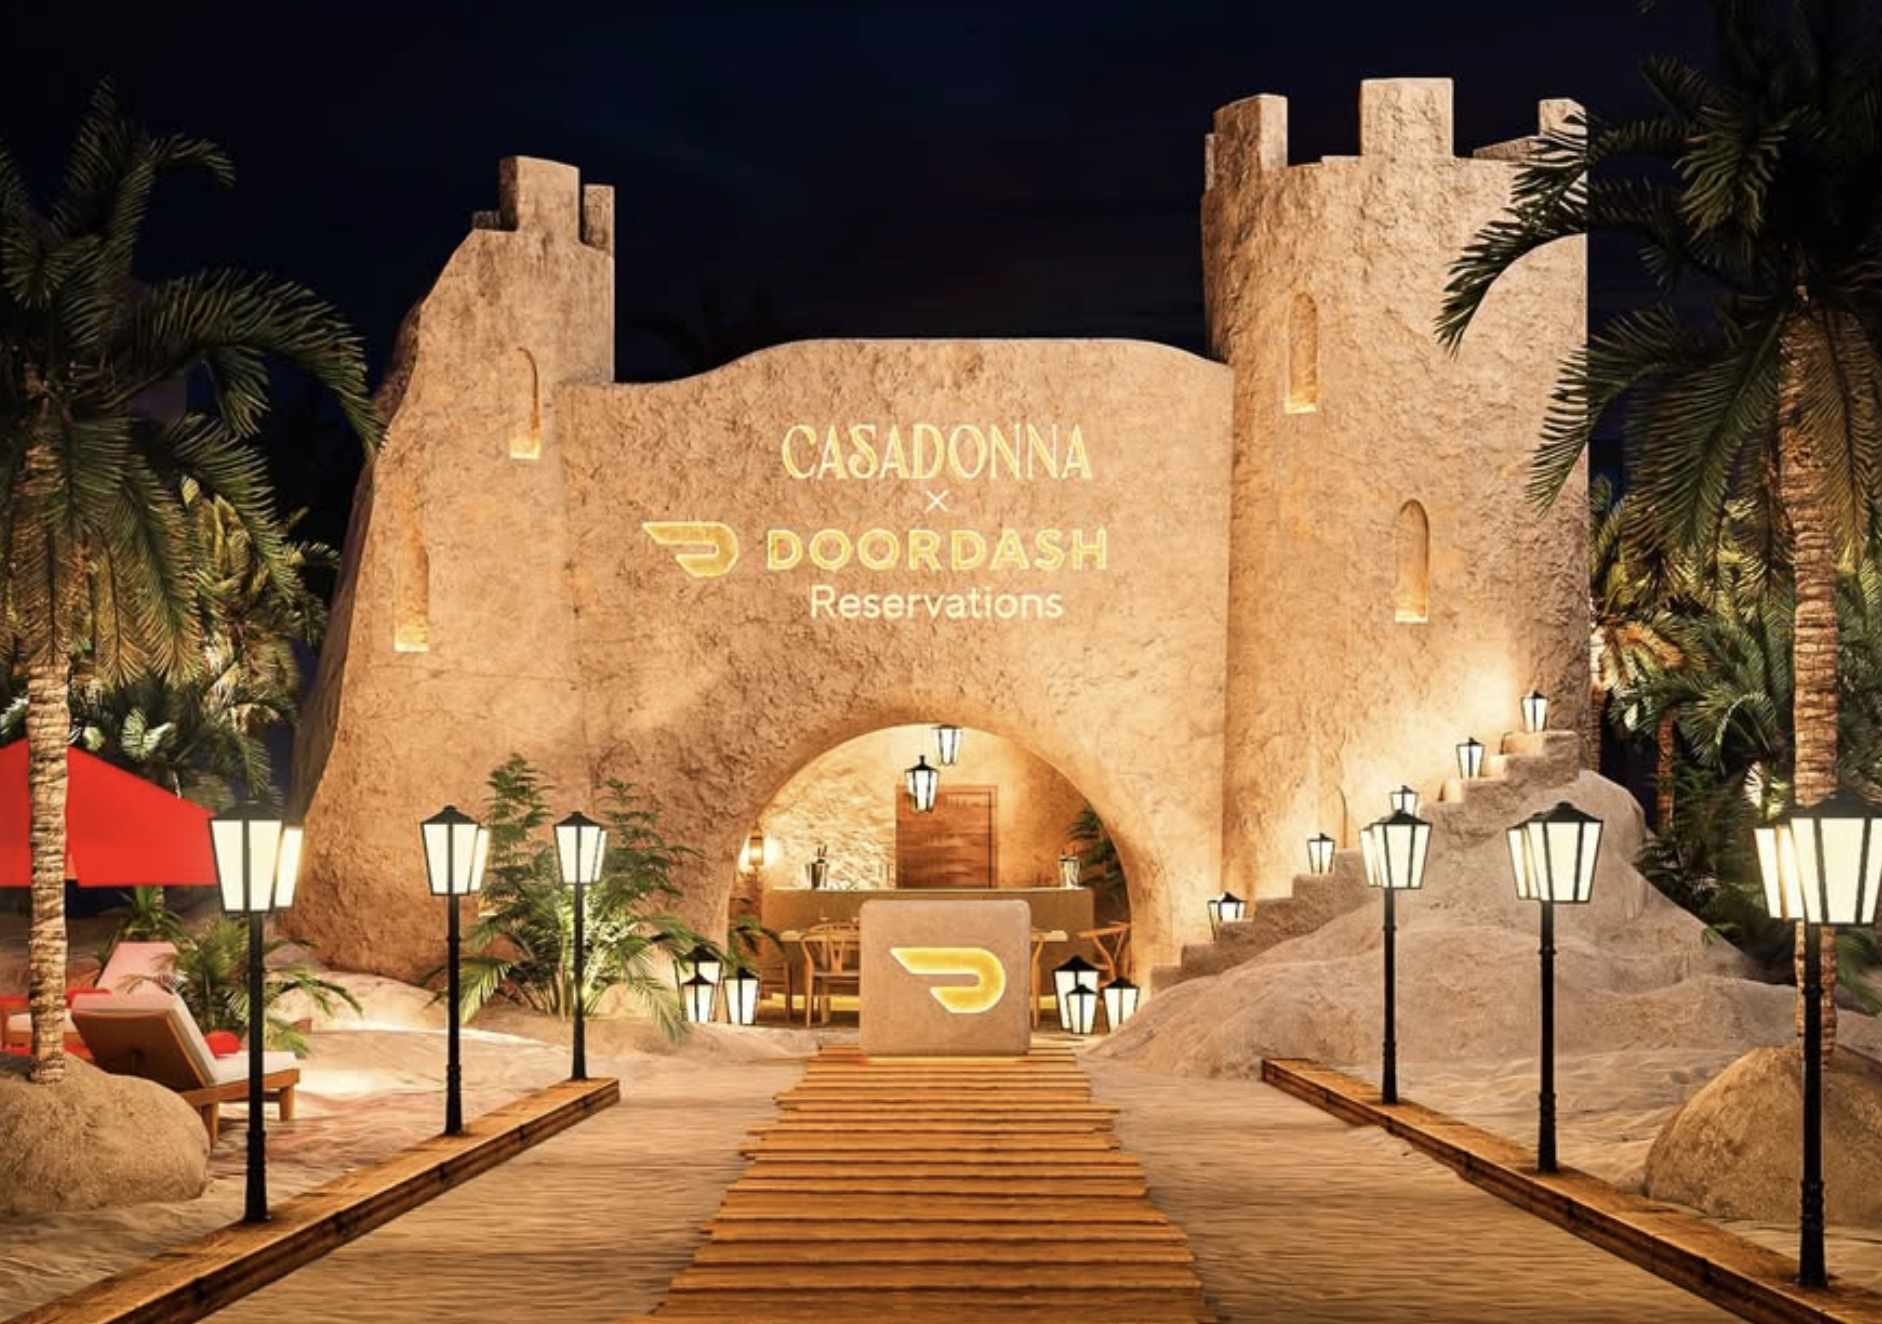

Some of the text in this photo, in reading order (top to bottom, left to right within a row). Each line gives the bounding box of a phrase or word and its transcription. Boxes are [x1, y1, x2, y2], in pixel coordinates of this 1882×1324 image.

[781, 423, 1093, 480] CASADONNA
[766, 528, 1108, 571] DOORDASH
[809, 584, 1064, 620] Reservations
